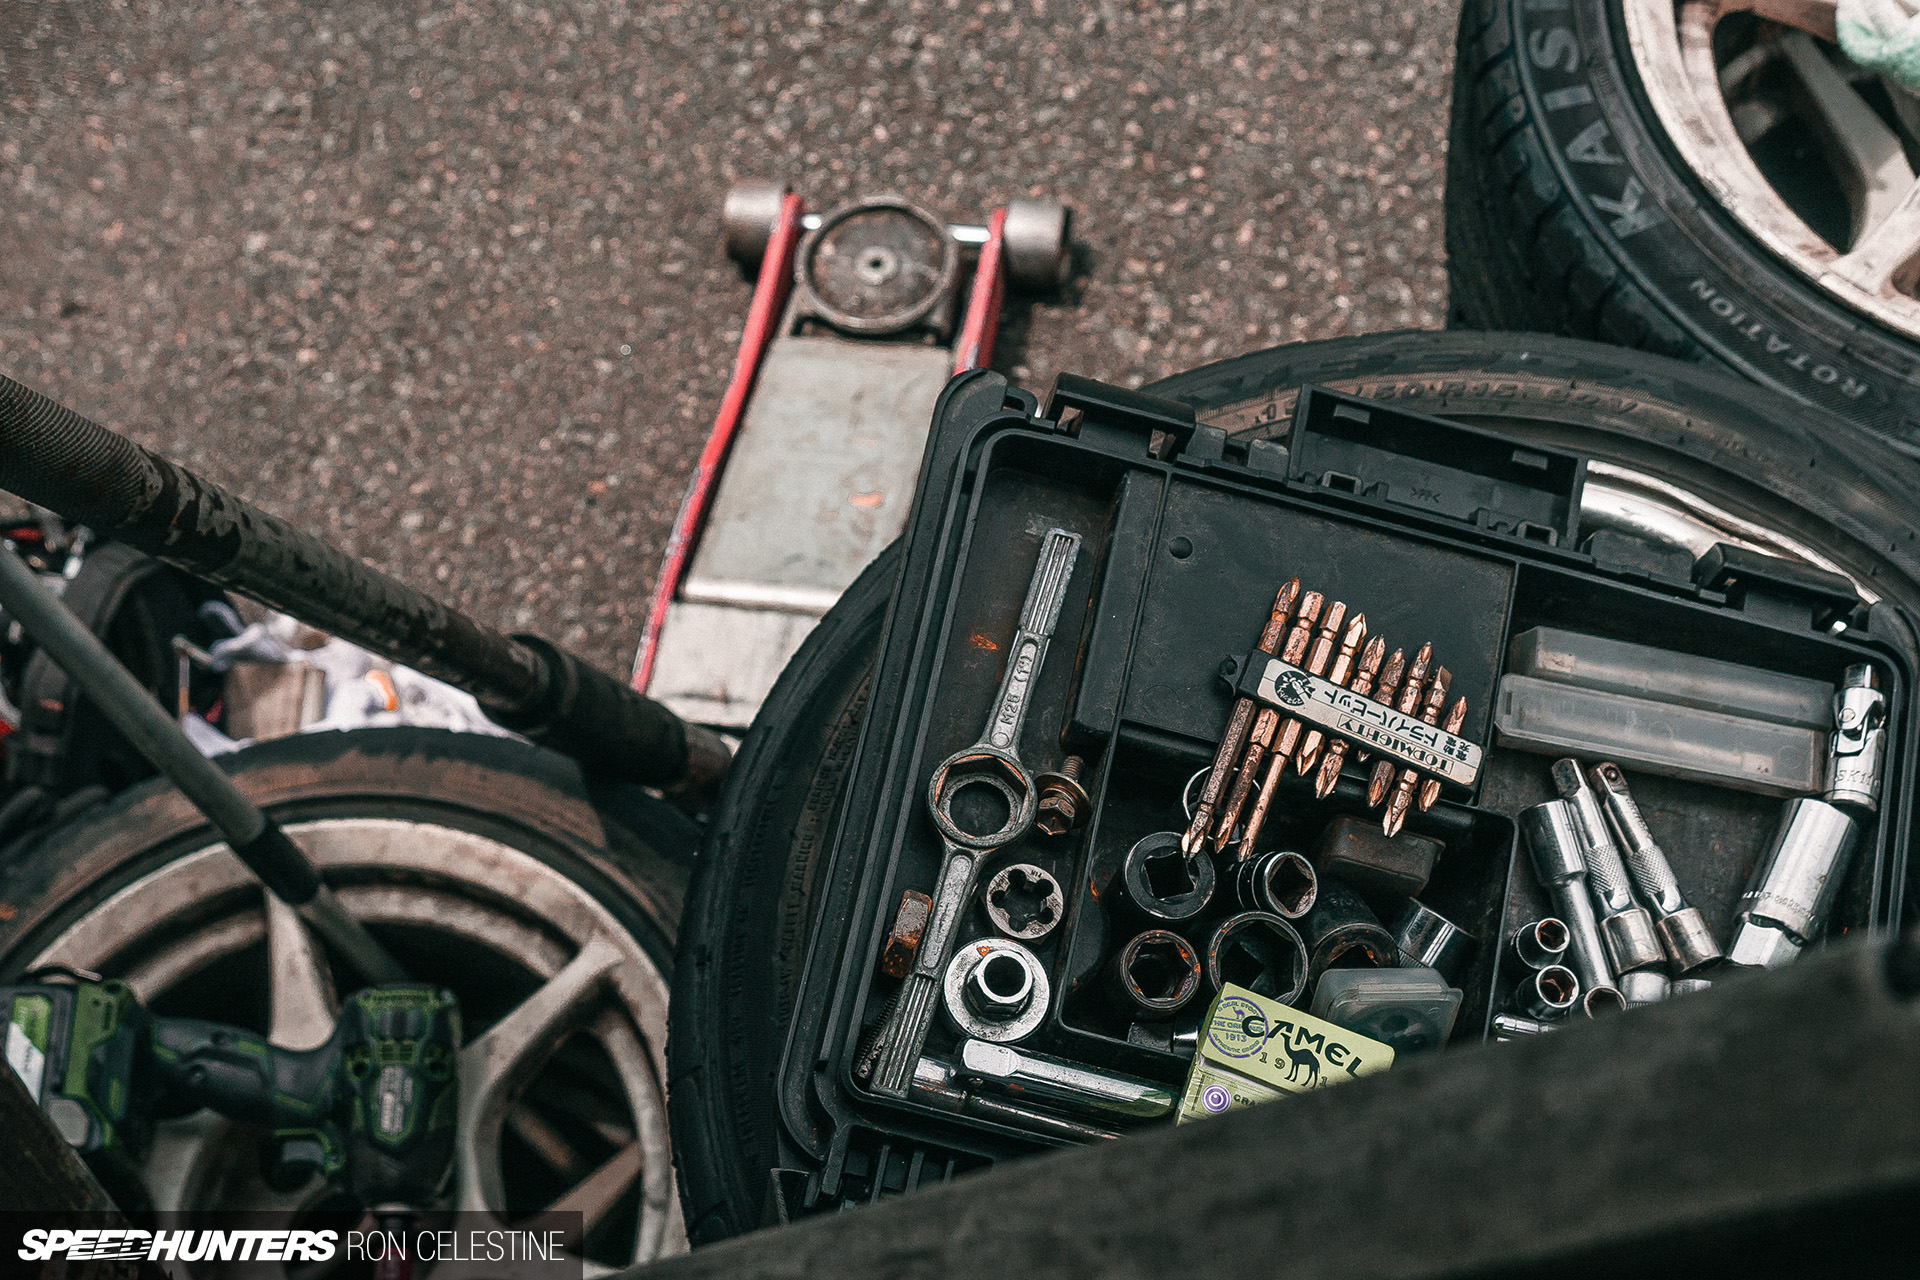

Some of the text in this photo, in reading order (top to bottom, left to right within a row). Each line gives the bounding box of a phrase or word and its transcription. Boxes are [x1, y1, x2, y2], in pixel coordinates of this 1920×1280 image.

[1527, 0, 1667, 240] KAIS
[1688, 278, 1869, 402] ROTATION
[1322, 686, 1439, 747] ドライバービット
[1339, 715, 1451, 773] TOPMIGHTY
[1225, 1032, 1247, 1042] 1913
[1241, 1015, 1364, 1080] CAMEL
